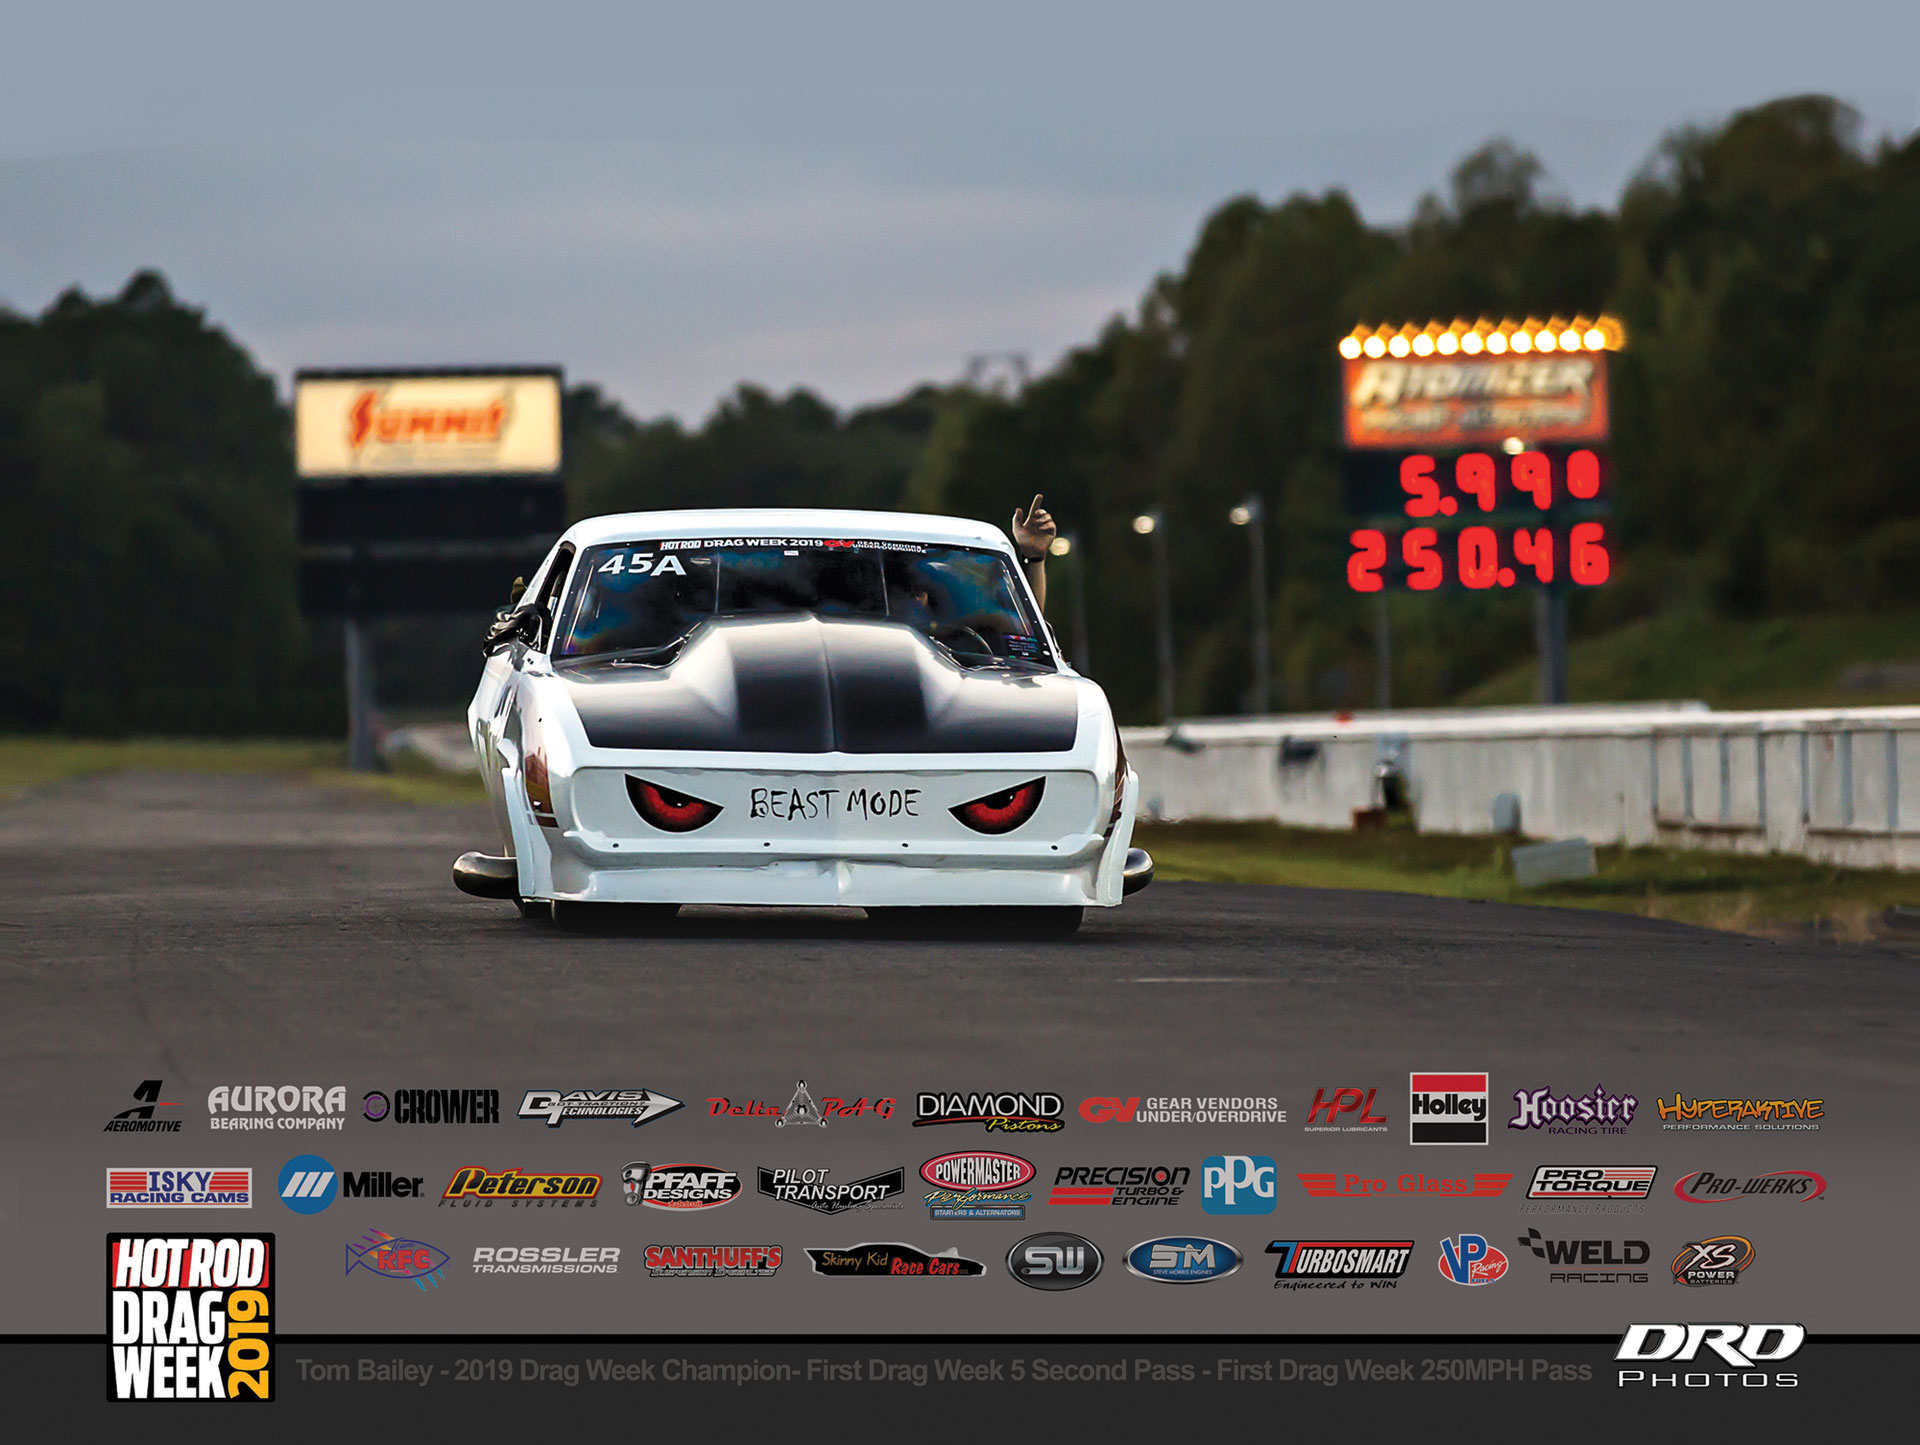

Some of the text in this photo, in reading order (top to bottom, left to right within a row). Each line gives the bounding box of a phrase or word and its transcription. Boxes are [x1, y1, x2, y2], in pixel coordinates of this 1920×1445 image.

[1400, 450, 1599, 517] 5.990
[704, 539, 744, 548] DRAG
[746, 539, 788, 547] WEEK
[790, 538, 823, 547] 2019
[1347, 522, 1609, 592] 250.46
[597, 553, 687, 576] 45A
[750, 786, 922, 821] BEAST MODE
